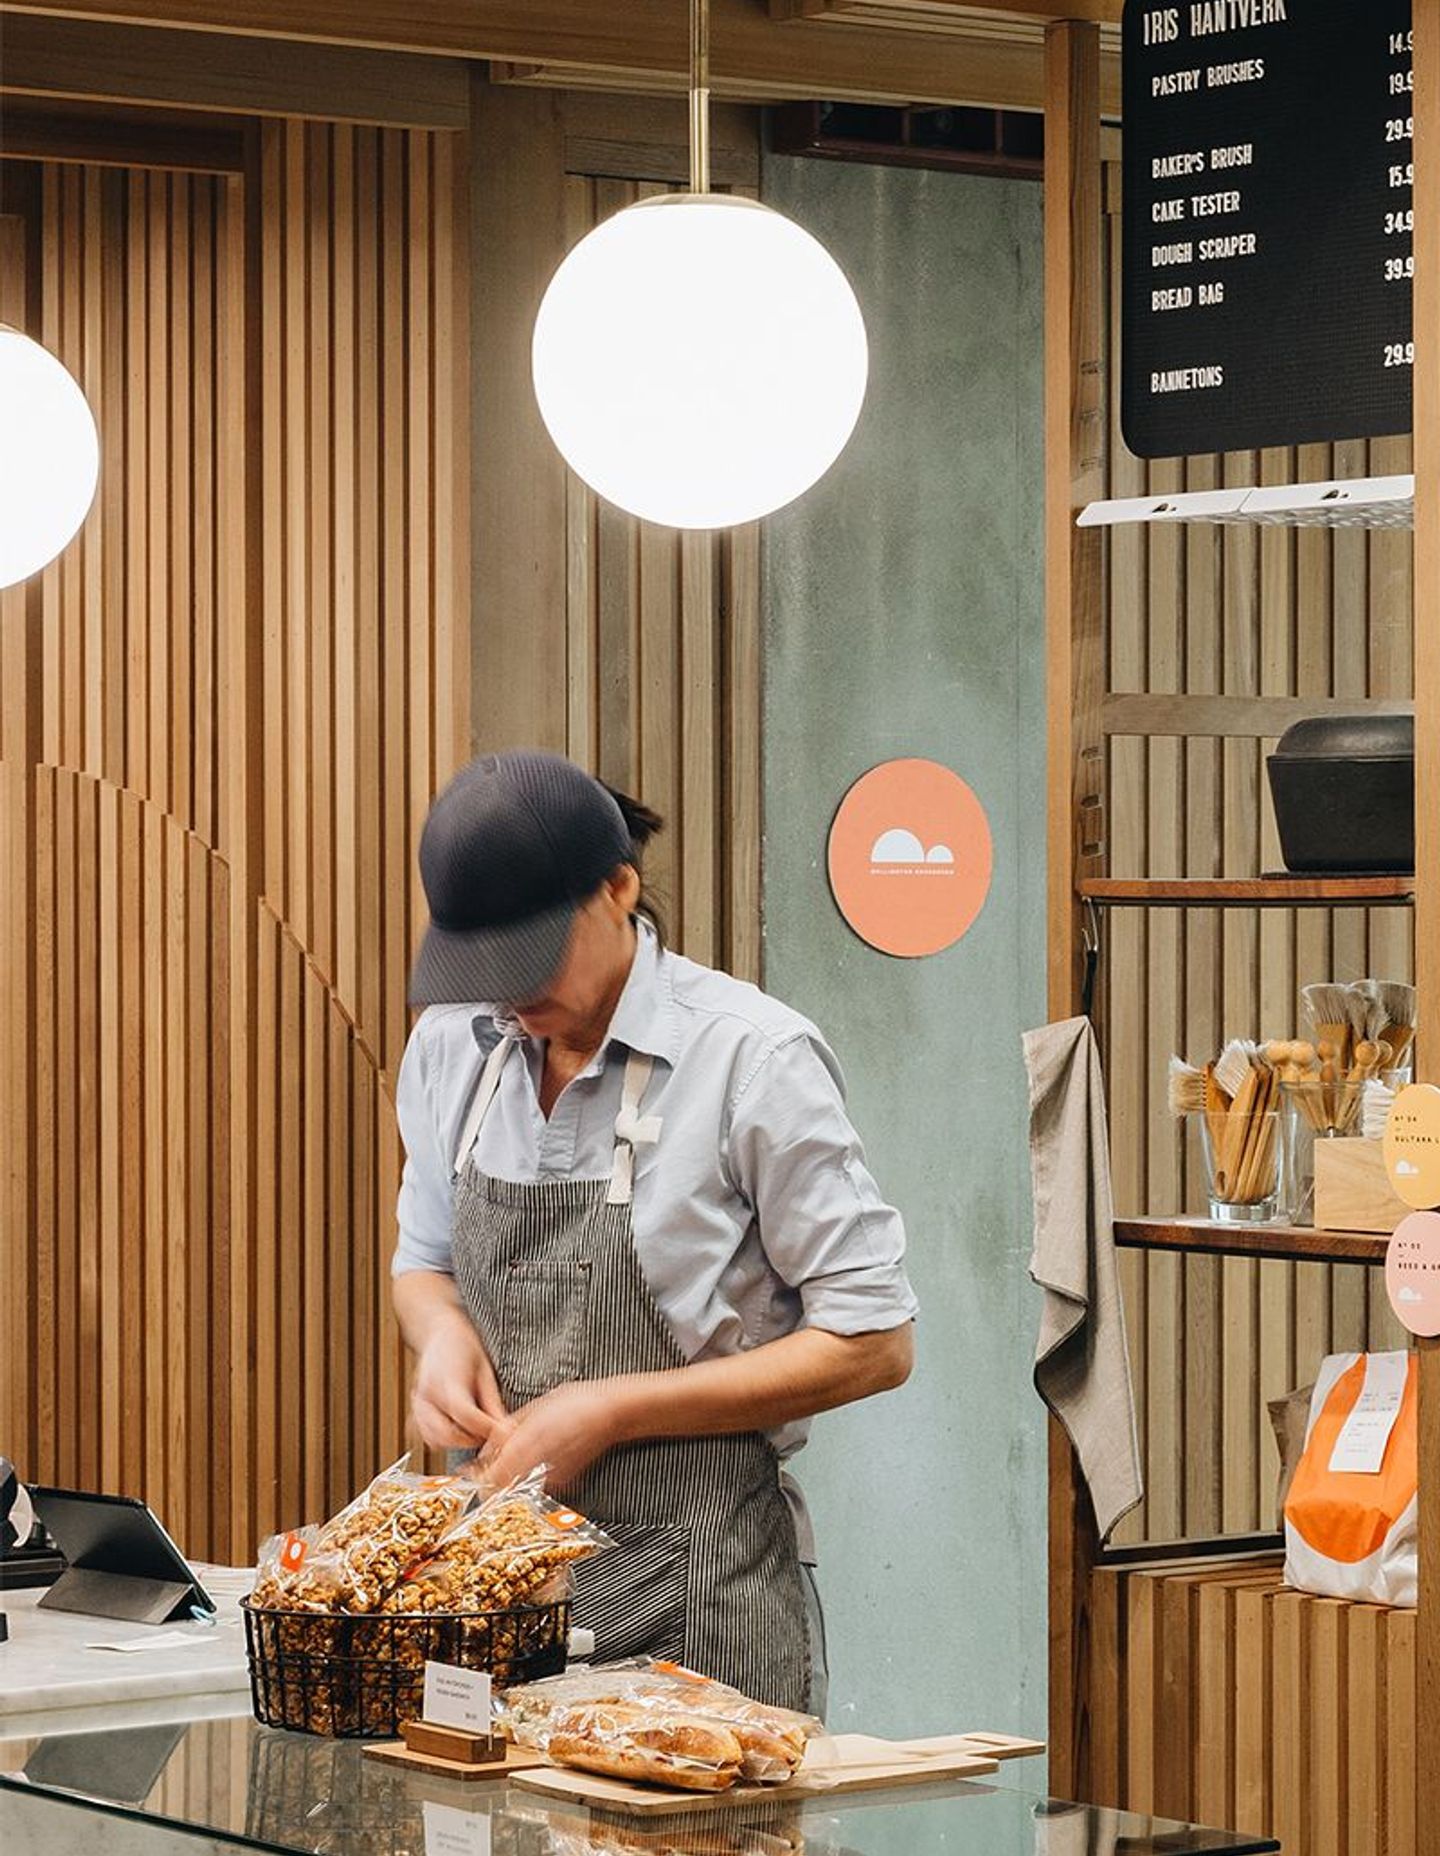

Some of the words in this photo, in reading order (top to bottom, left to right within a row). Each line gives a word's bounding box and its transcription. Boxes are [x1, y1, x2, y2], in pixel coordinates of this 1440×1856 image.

[1144, 9, 1178, 45] IRIS
[1153, 70, 1200, 96] PASTRY
[1208, 59, 1264, 86] BRUSHES
[1153, 152, 1204, 178] BAKER'S
[1212, 144, 1252, 169] BRUSH
[1153, 199, 1184, 222] CAKE
[1192, 191, 1240, 216] TESTER
[1152, 243, 1192, 266] DOUGH
[1199, 234, 1255, 260] SCRAPER
[1152, 287, 1192, 311] BREAD
[1199, 283, 1223, 305] BAG
[1151, 366, 1222, 392] BANNETONS
[1394, 1135, 1432, 1143] SULTANA
